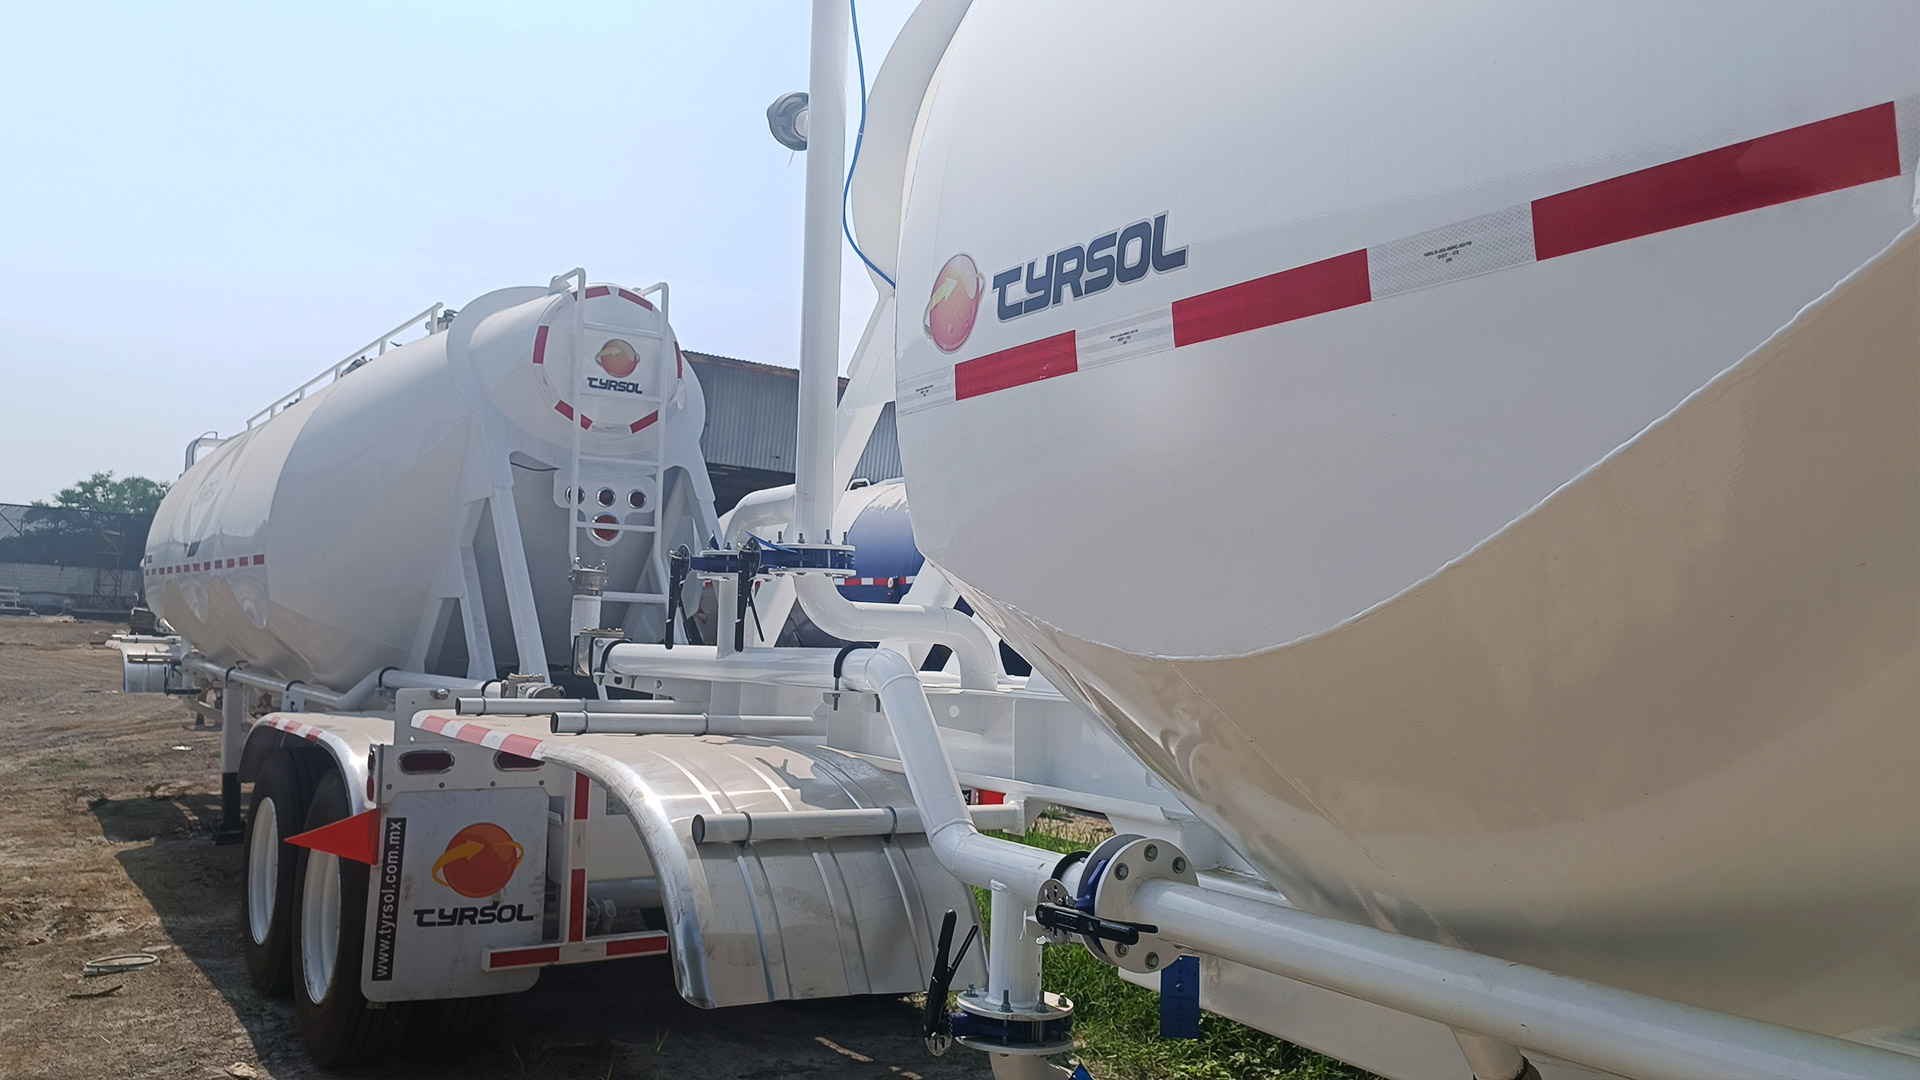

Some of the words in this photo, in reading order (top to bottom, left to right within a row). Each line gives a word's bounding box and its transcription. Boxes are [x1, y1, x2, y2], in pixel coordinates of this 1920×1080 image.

[992, 211, 1188, 322] TYRSOL
[586, 376, 643, 395] TYRSOL
[376, 821, 403, 978] www.tyrsol.com.mx
[413, 903, 535, 928] TYRSOL
